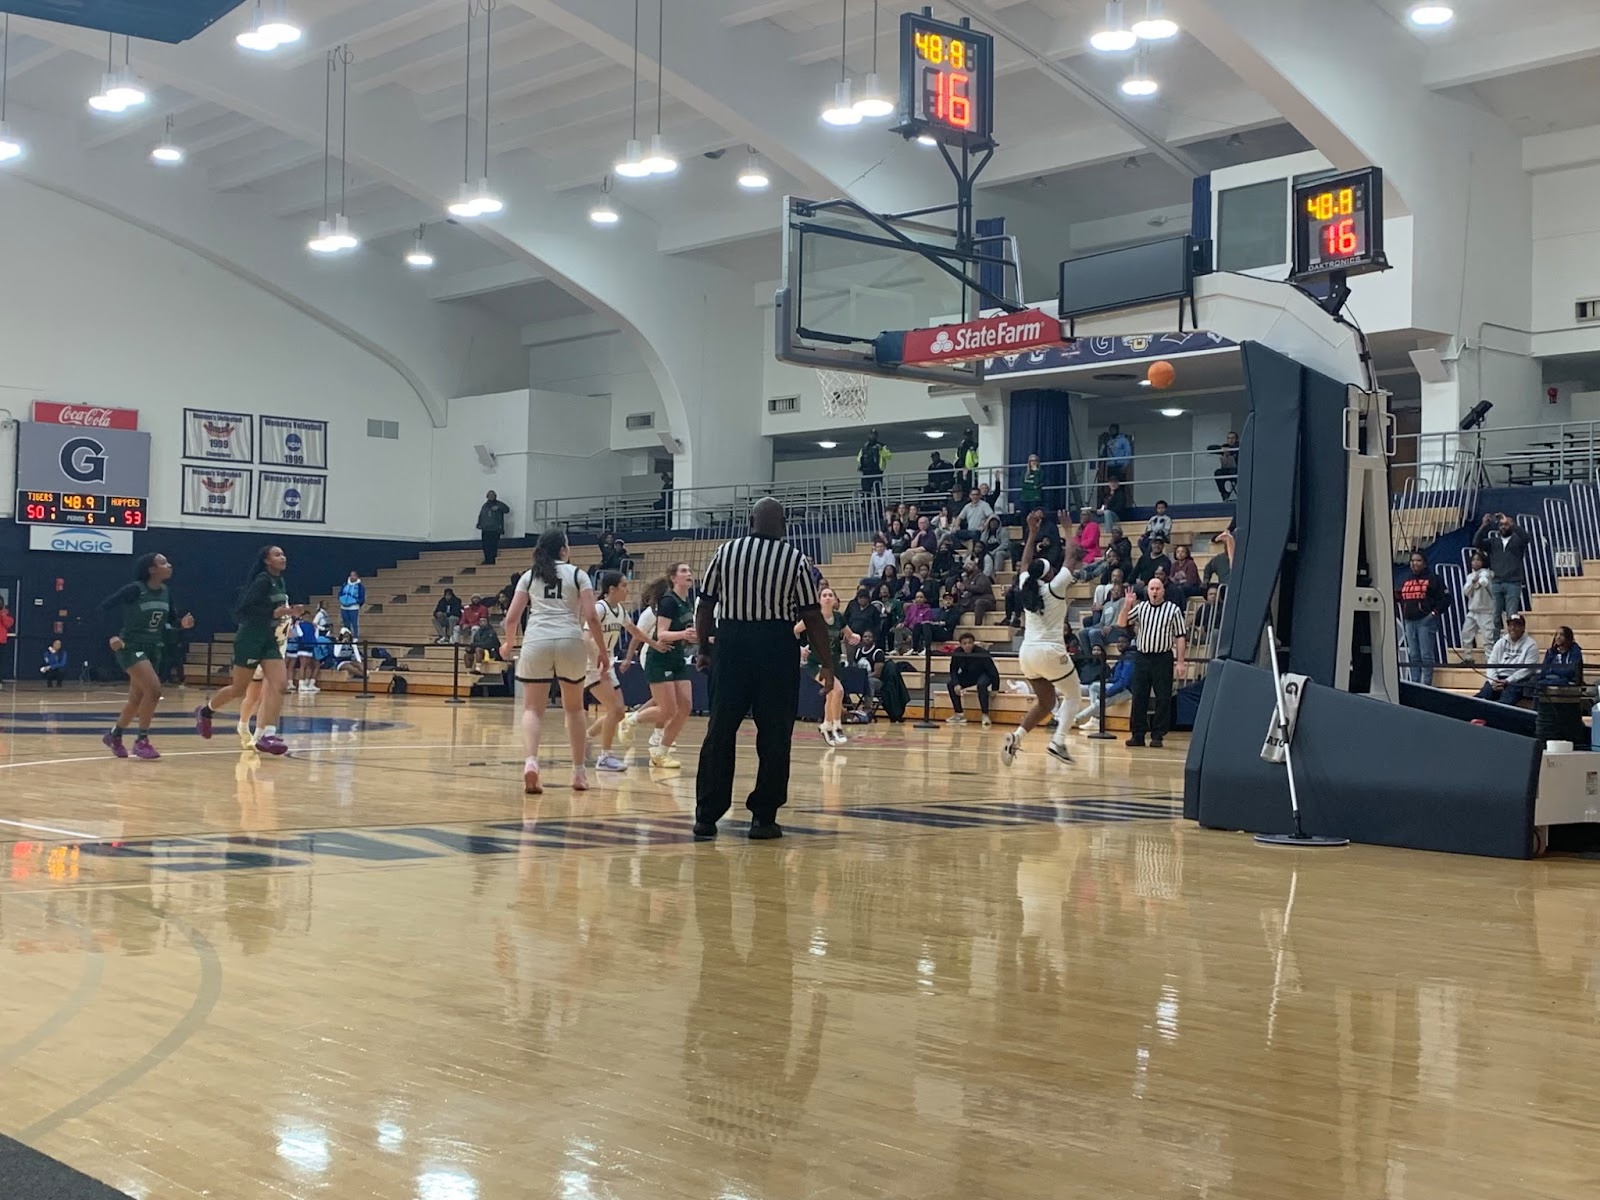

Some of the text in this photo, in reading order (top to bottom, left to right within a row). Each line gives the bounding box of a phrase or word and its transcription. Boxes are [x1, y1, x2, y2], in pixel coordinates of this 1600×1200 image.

[936, 71, 970, 126] 16
[1328, 218, 1357, 255] 16
[1308, 256, 1362, 272] DAKTRONICS
[59, 436, 109, 485] G
[284, 454, 304, 465] 1999
[27, 492, 54, 502] TIGERS
[63, 495, 95, 509] 48.9
[26, 504, 45, 519] 50
[87, 512, 95, 524] 5
[124, 510, 142, 525] 53
[544, 577, 563, 599] 21
[149, 611, 163, 628] 5
